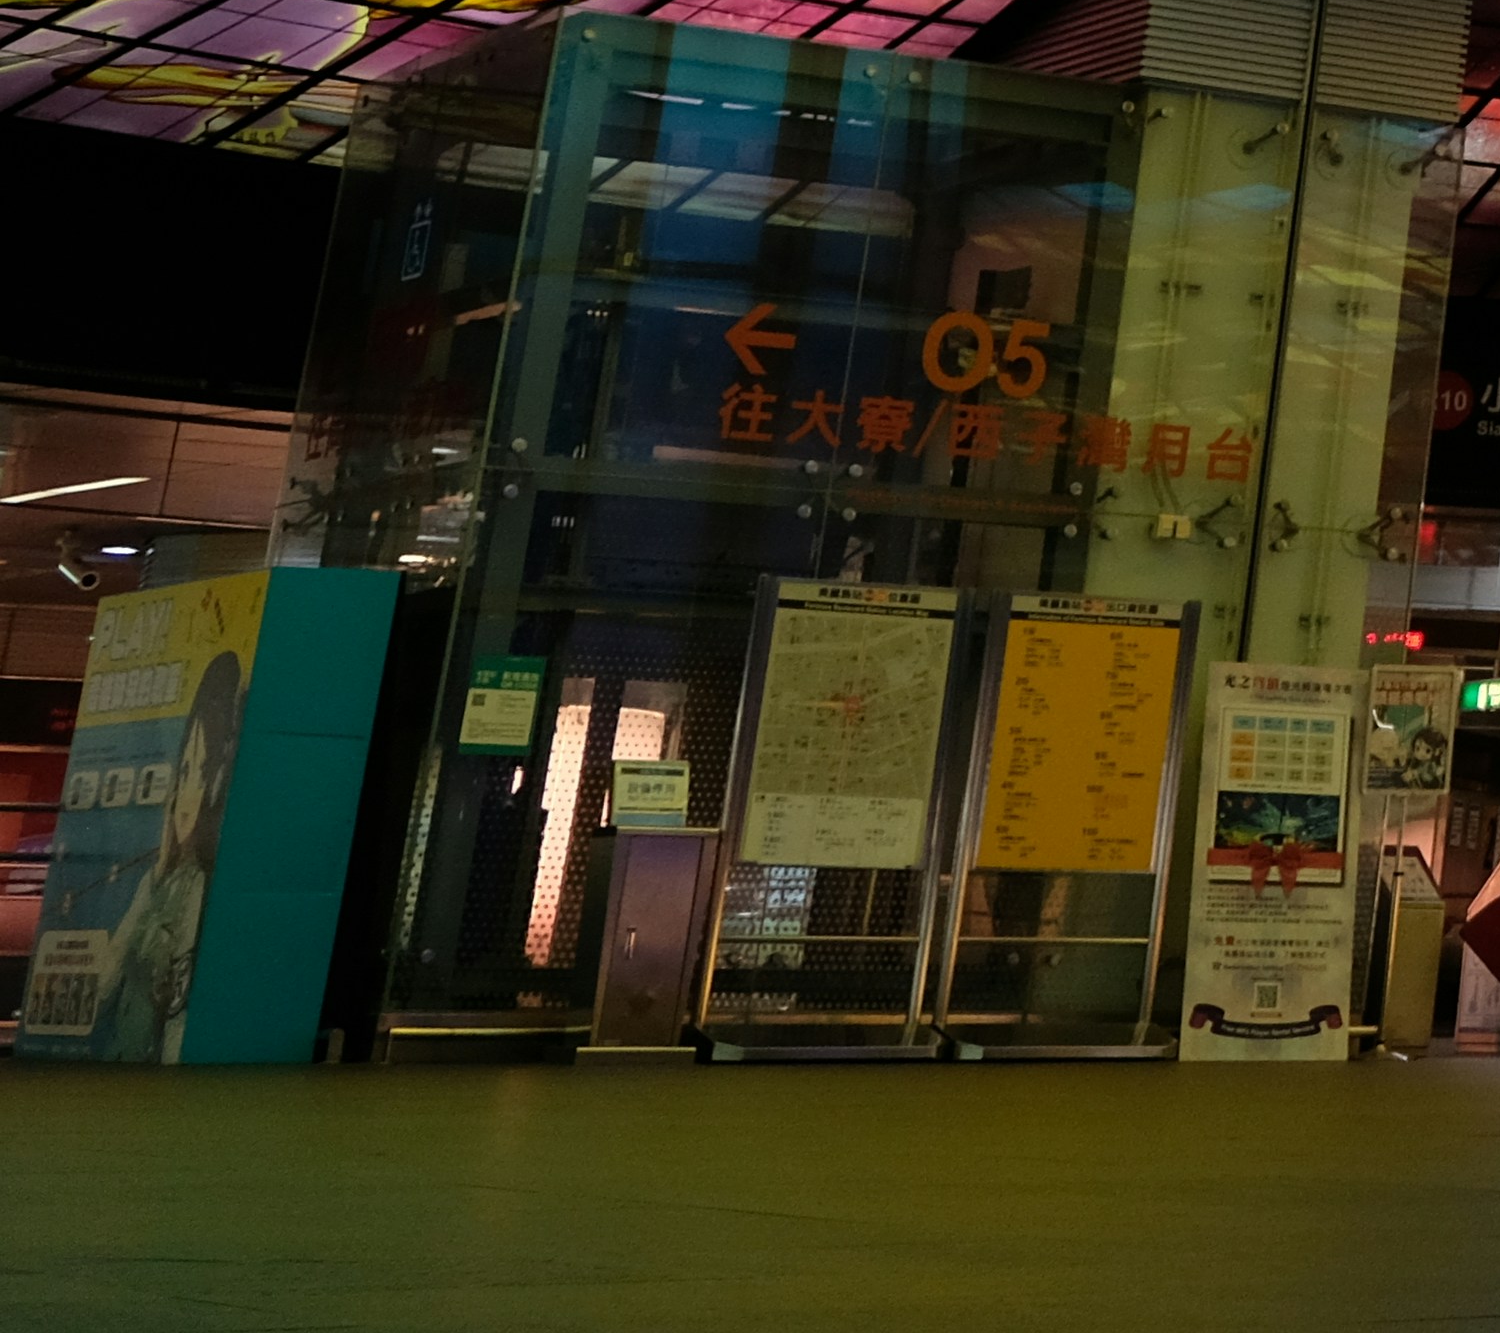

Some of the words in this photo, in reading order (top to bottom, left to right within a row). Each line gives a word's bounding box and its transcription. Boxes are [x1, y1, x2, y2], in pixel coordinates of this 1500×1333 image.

[718, 381, 1254, 484] 往大寮/西子灣月台
